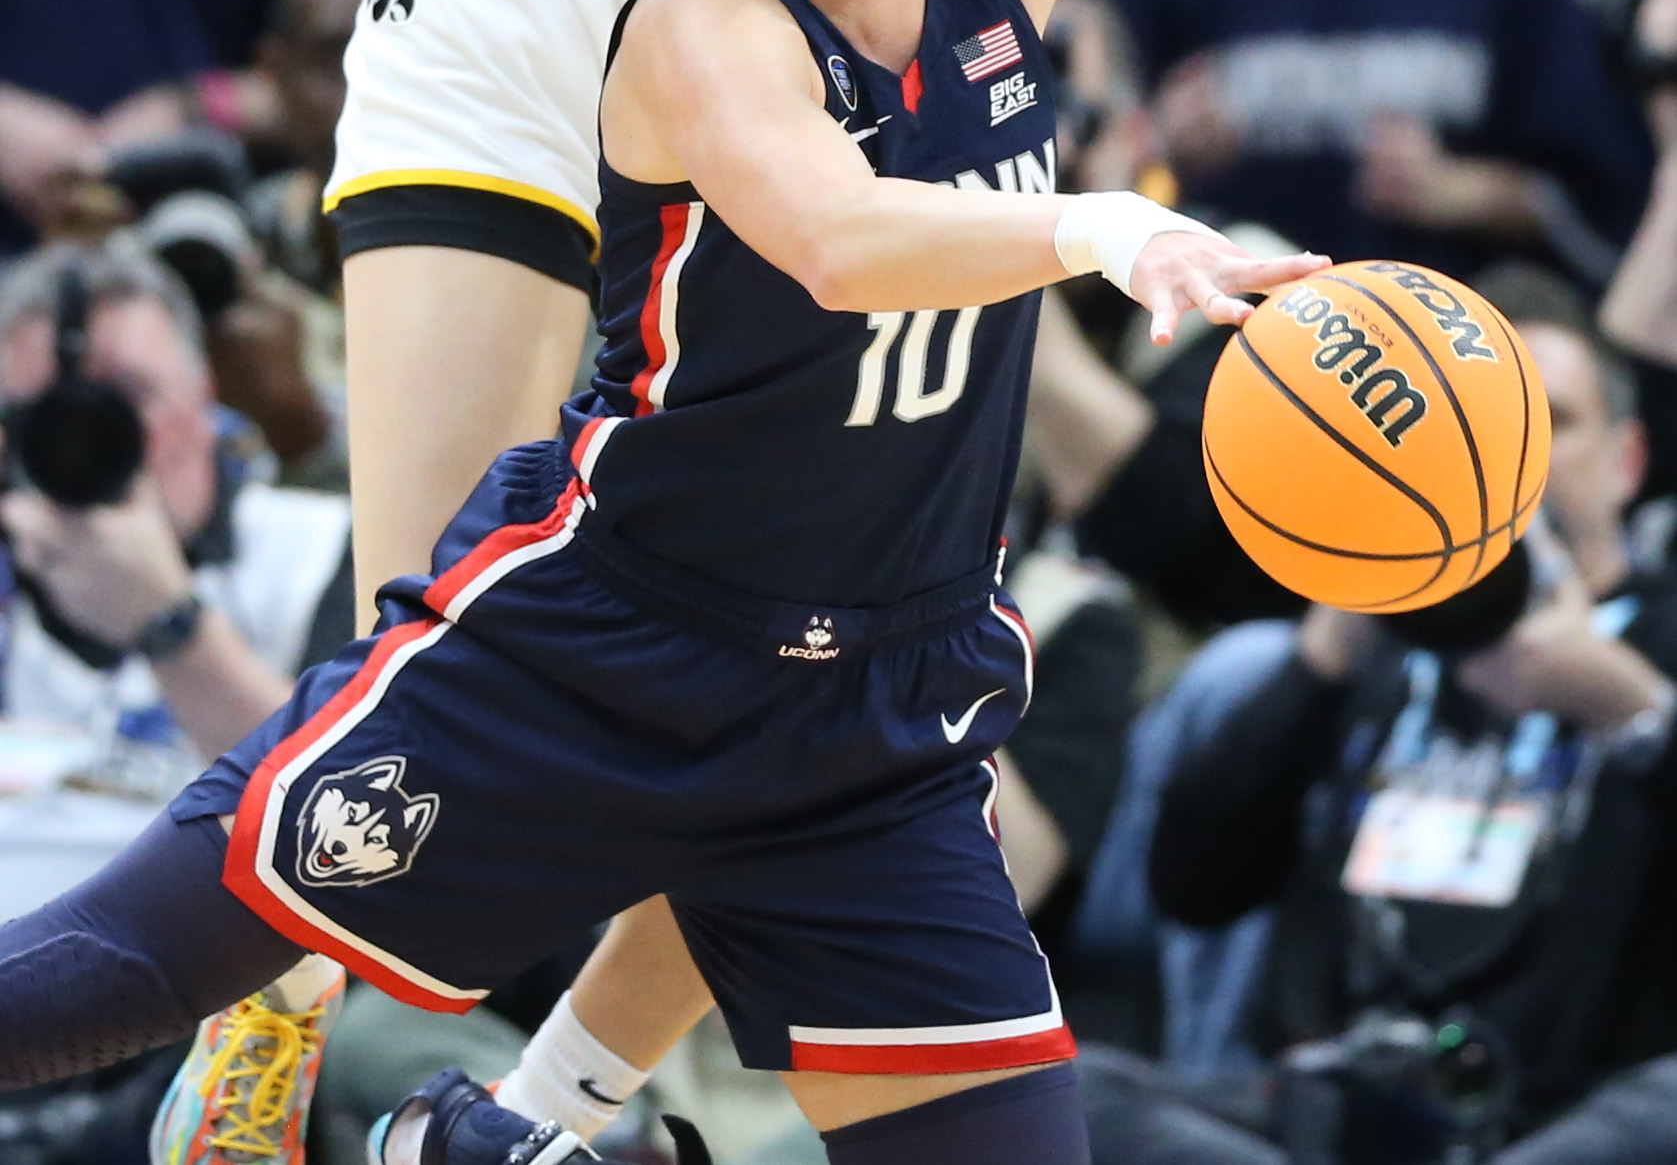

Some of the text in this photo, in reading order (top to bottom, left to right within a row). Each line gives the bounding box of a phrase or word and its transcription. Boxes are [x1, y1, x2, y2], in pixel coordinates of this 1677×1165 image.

[990, 71, 1025, 102] BIG
[991, 82, 1037, 118] EAST
[844, 305, 983, 427] 10
[1276, 285, 1428, 450] Wilson
[779, 645, 840, 660] UCONN
